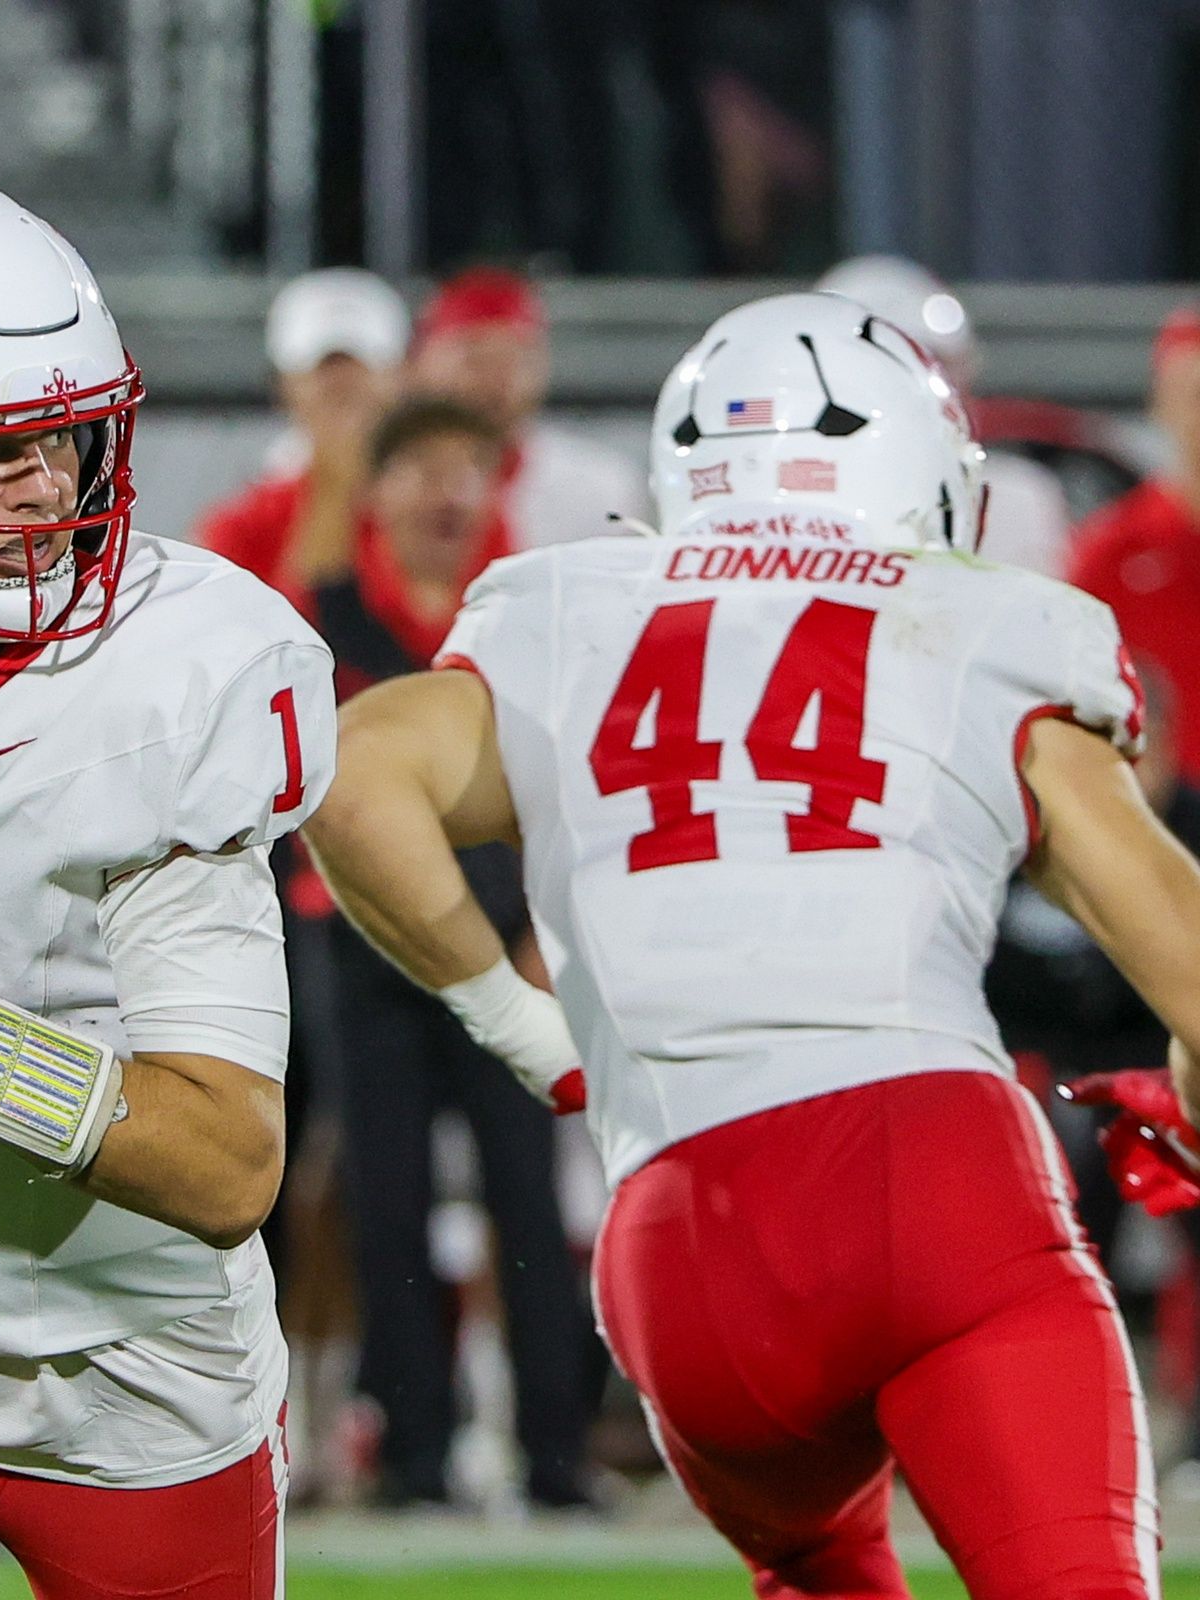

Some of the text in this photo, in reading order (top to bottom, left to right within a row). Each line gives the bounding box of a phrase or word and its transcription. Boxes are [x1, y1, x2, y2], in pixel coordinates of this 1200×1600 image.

[665, 545, 915, 587] CONNORS
[270, 686, 307, 814] 1
[588, 597, 887, 874] 44
